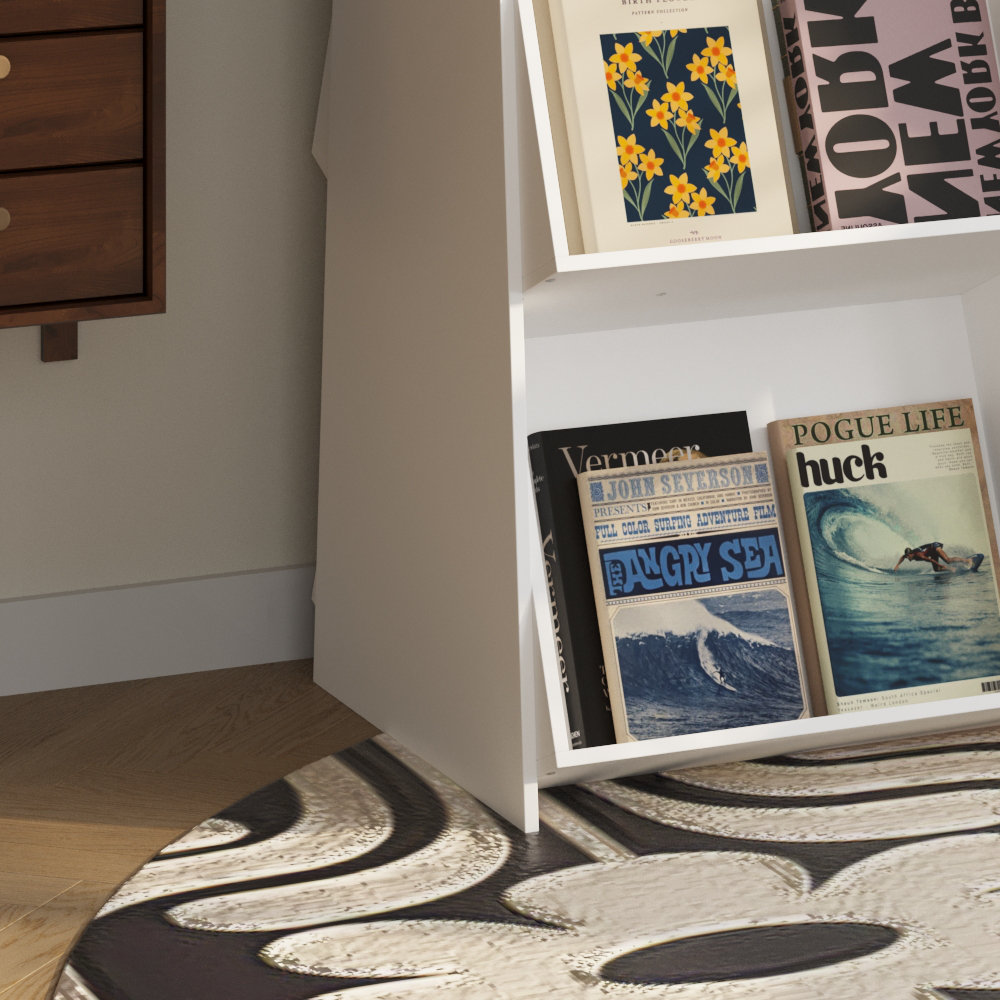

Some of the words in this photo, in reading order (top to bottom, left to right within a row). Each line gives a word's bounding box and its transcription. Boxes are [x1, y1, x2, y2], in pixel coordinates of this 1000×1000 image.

[792, 413, 894, 446] POGUE
[901, 406, 965, 433] LIFE
[558, 442, 700, 479] Vermeer
[796, 444, 888, 488] huck
[607, 474, 656, 502] JOHN
[661, 465, 753, 495] SEVERSON
[594, 525, 617, 540] FULL
[622, 520, 650, 537] COLOR
[655, 515, 692, 532] SURFING
[696, 507, 750, 528] ADVENTURE
[753, 504, 777, 520] FILM
[610, 543, 712, 593] ANGRY
[720, 534, 785, 582] SEA
